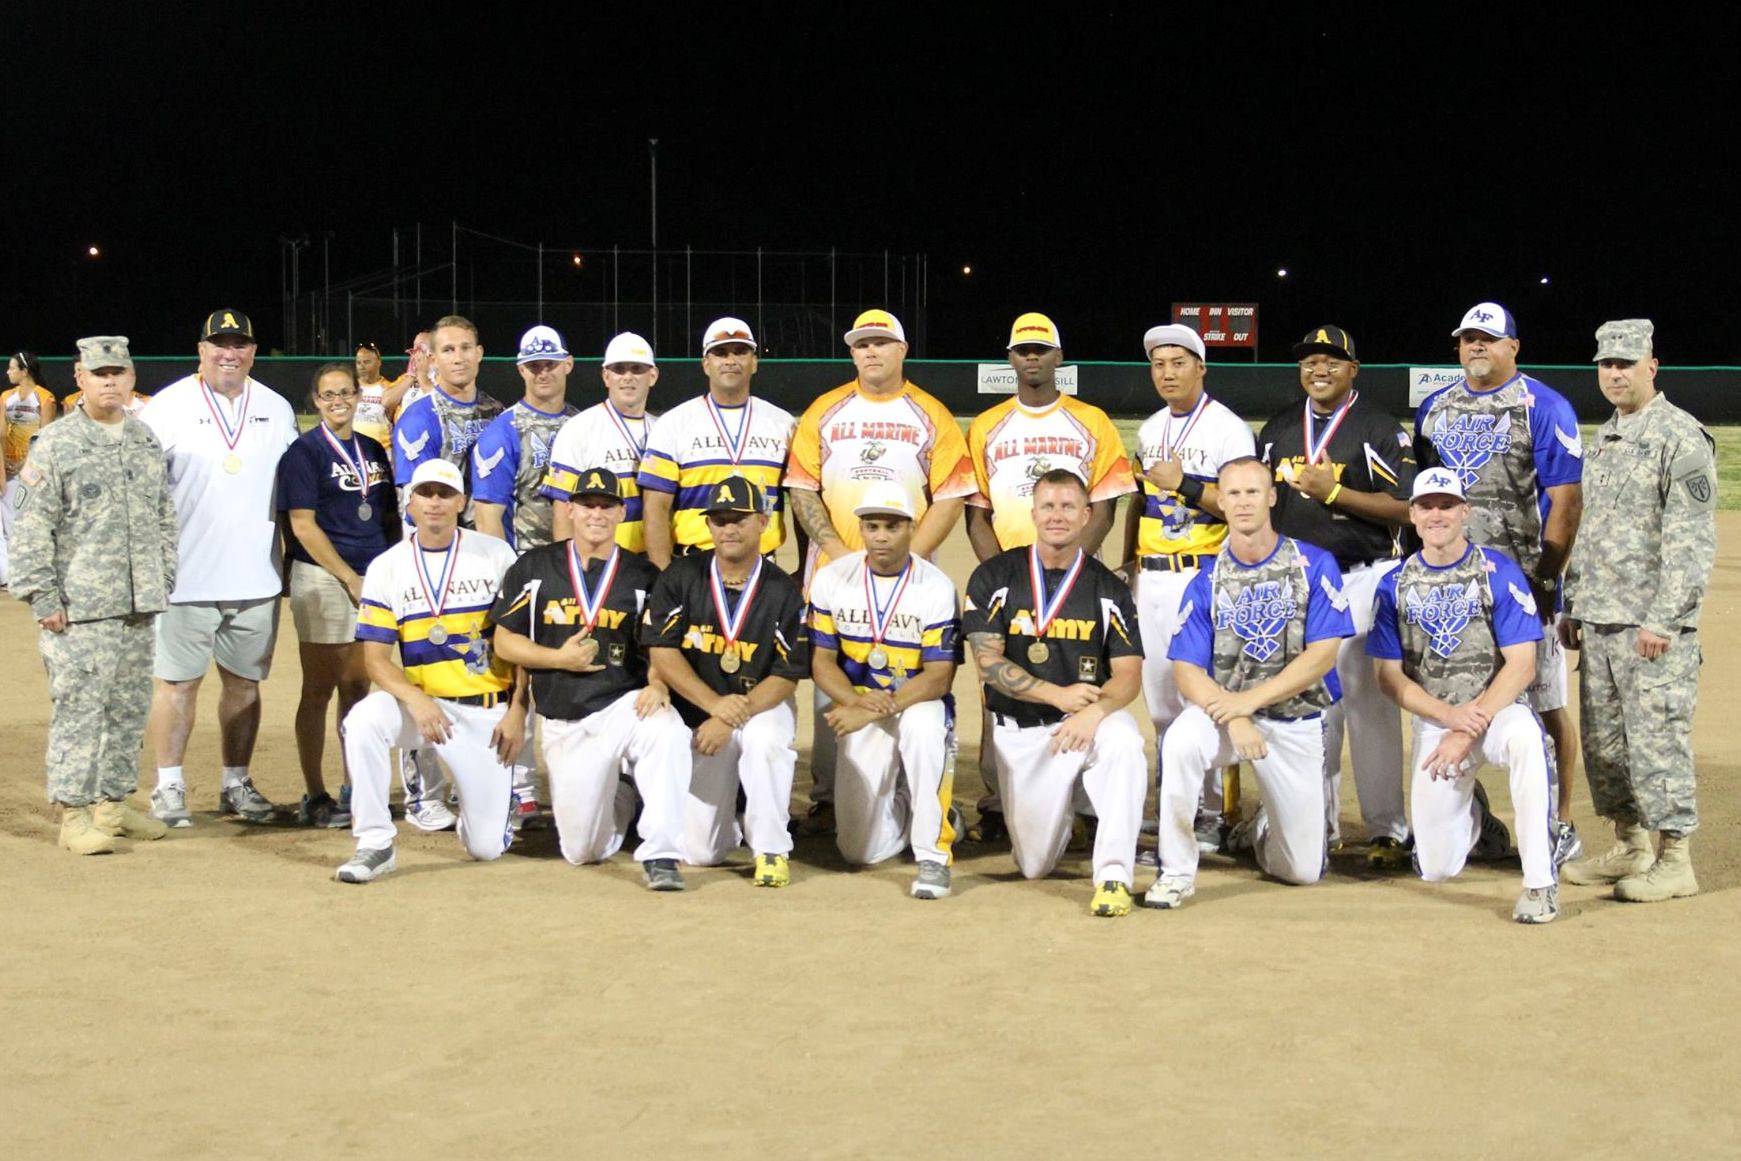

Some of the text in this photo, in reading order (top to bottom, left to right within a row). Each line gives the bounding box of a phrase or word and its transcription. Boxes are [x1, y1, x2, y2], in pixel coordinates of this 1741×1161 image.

[220, 312, 240, 329] A
[1180, 307, 1200, 316] HOME
[1227, 307, 1254, 316] VISITOR
[1469, 309, 1494, 323] AF
[1203, 332, 1249, 342] STRIKE OUT
[1313, 329, 1332, 344] A
[1448, 413, 1496, 433] AIR
[831, 421, 921, 446] ALL MARINE
[1431, 431, 1512, 454] FORCE
[691, 436, 782, 452] ALL AVY
[994, 436, 1083, 462] ALL MARINE
[1175, 447, 1209, 466] AVY
[586, 472, 606, 489] A
[1424, 472, 1452, 488] AF
[716, 484, 736, 503] A
[403, 586, 426, 602] AL
[1235, 580, 1280, 607] AIR
[1422, 582, 1465, 605] AIR
[836, 607, 870, 624] ALL
[1215, 599, 1297, 631] FORCE
[1405, 598, 1482, 625] FORCE
